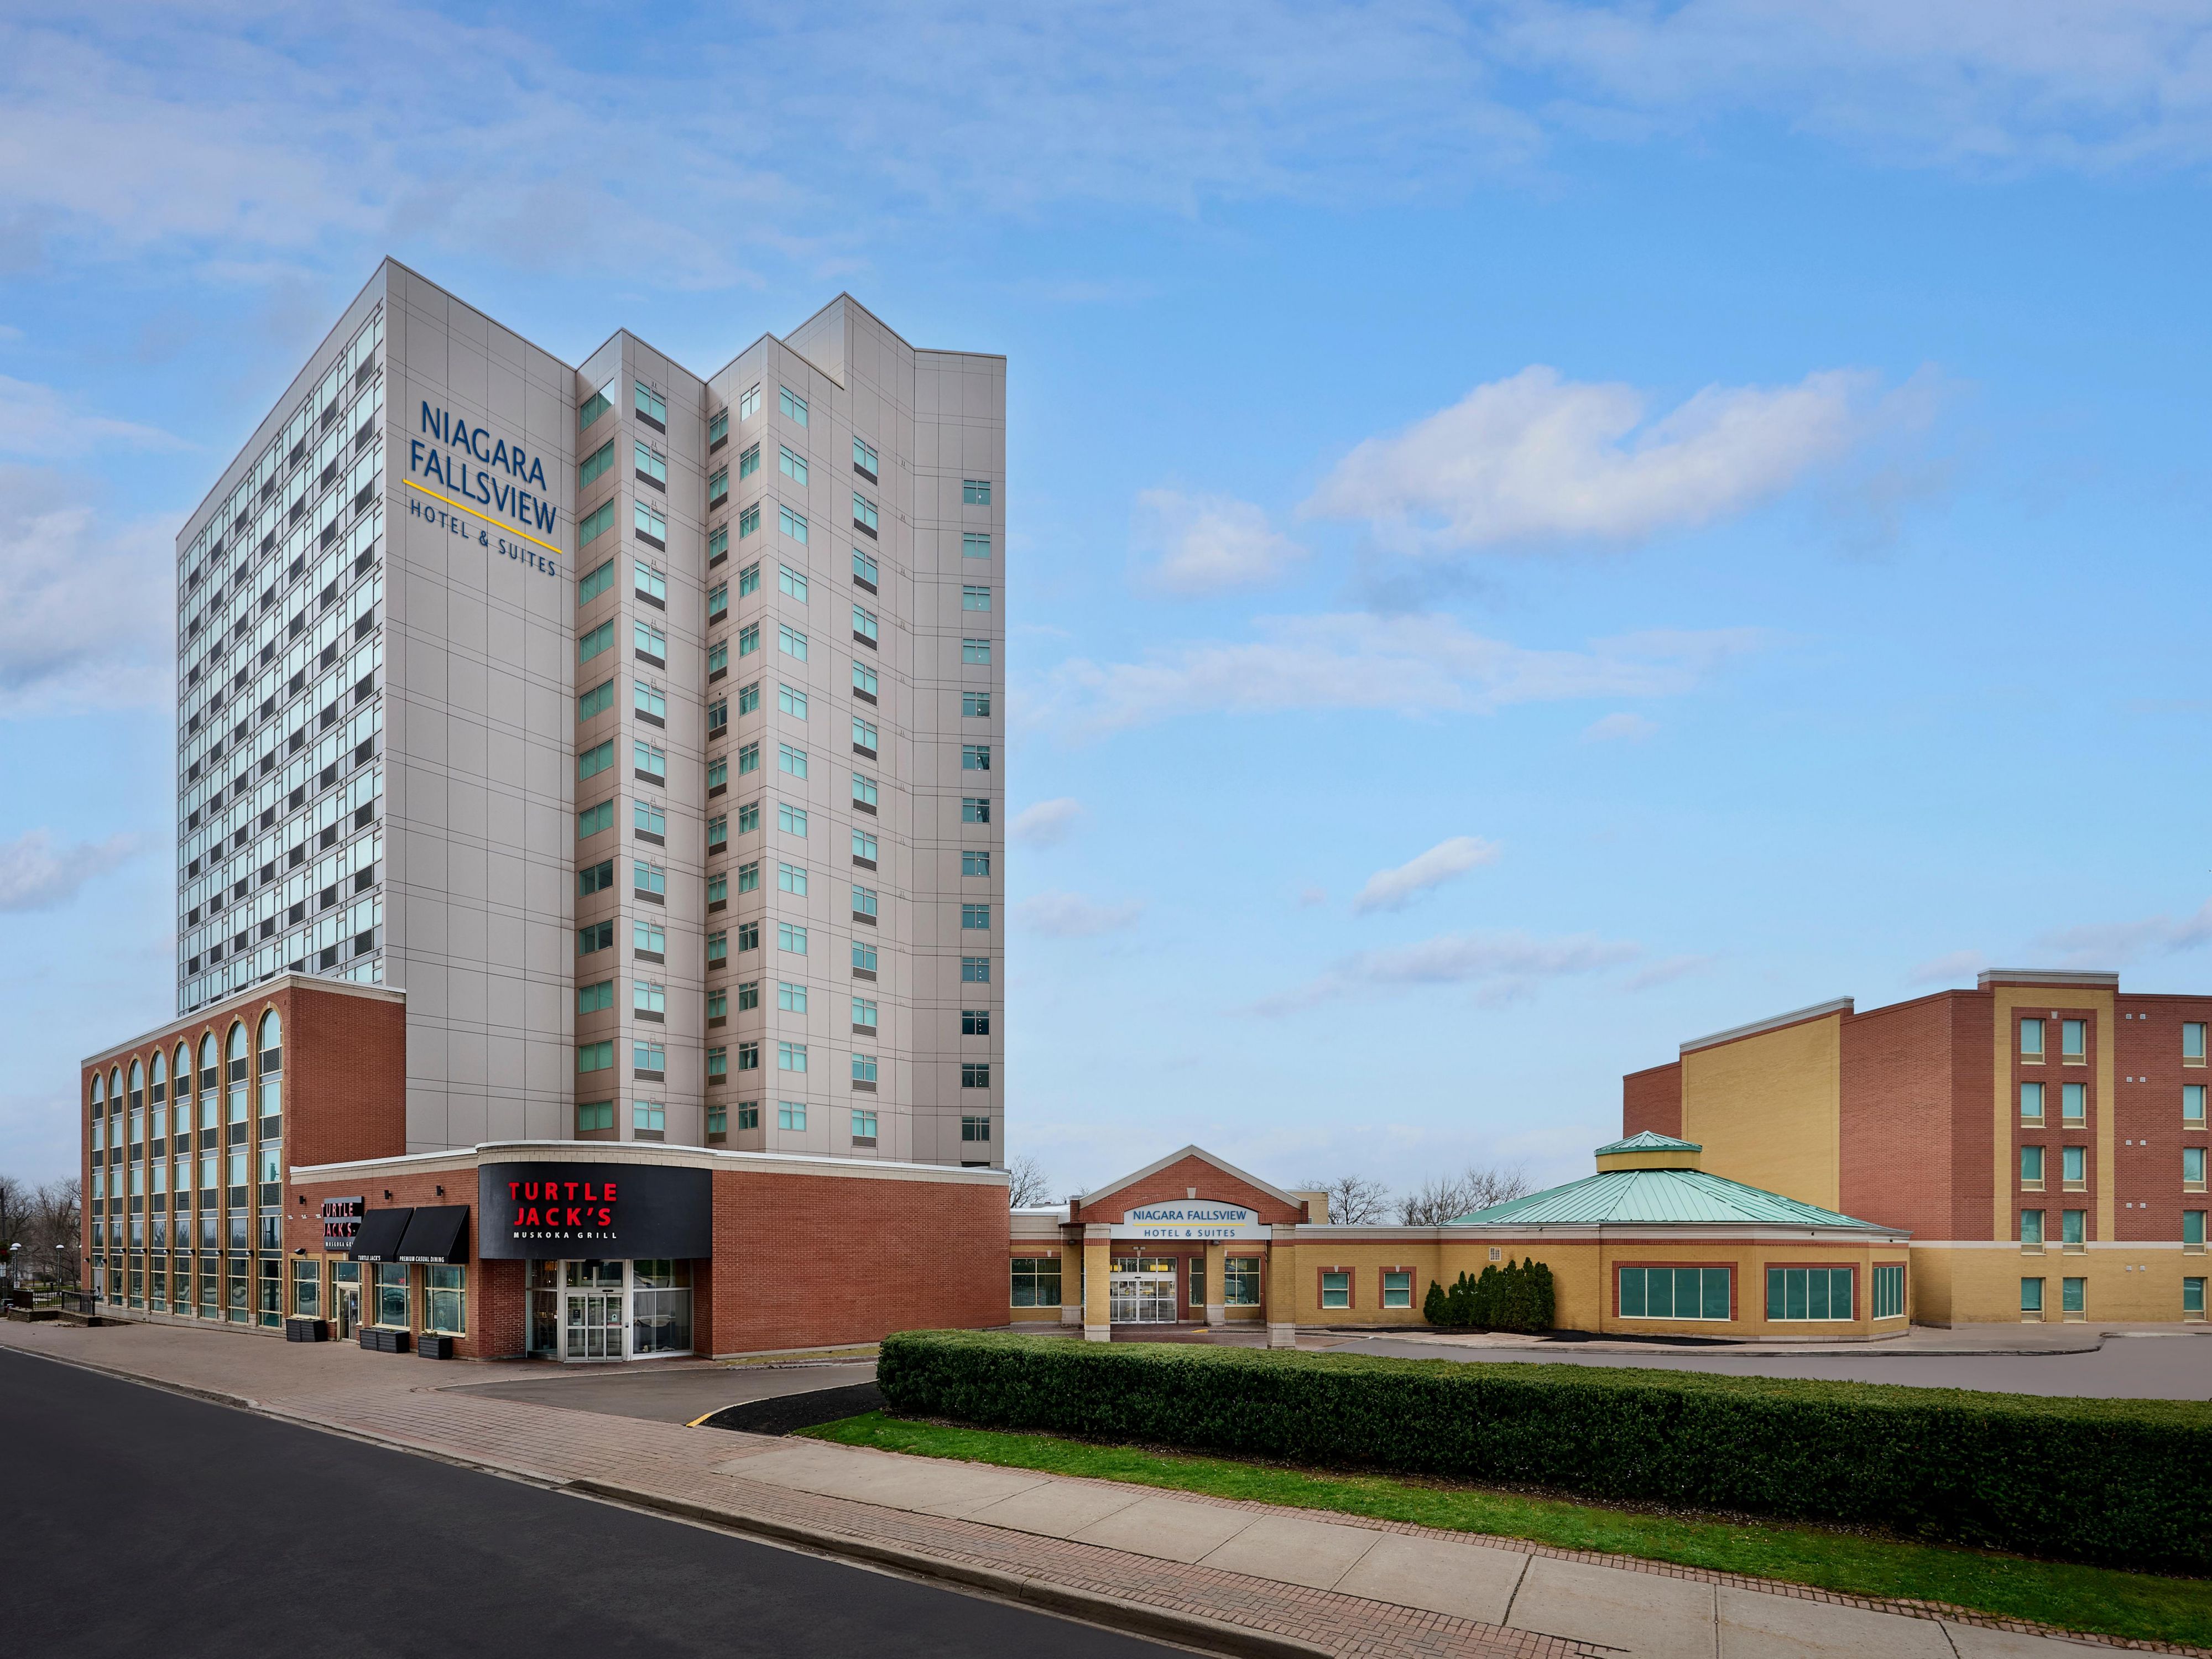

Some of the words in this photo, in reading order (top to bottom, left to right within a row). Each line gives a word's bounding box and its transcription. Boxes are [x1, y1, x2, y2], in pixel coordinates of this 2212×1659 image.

[422, 400, 547, 491] NIAGARA
[411, 439, 556, 534] FALLSVIEW
[411, 499, 469, 539] HOTEL
[479, 530, 488, 547] &
[499, 539, 555, 576] SUITES
[508, 1182, 617, 1201] TURTLE
[321, 1202, 353, 1217] TURTLE
[514, 1207, 611, 1226] JACK'S
[1134, 1211, 1183, 1220] NIAGARA
[1188, 1211, 1246, 1220] FALLSVIEW
[322, 1222, 352, 1237] JACK'S
